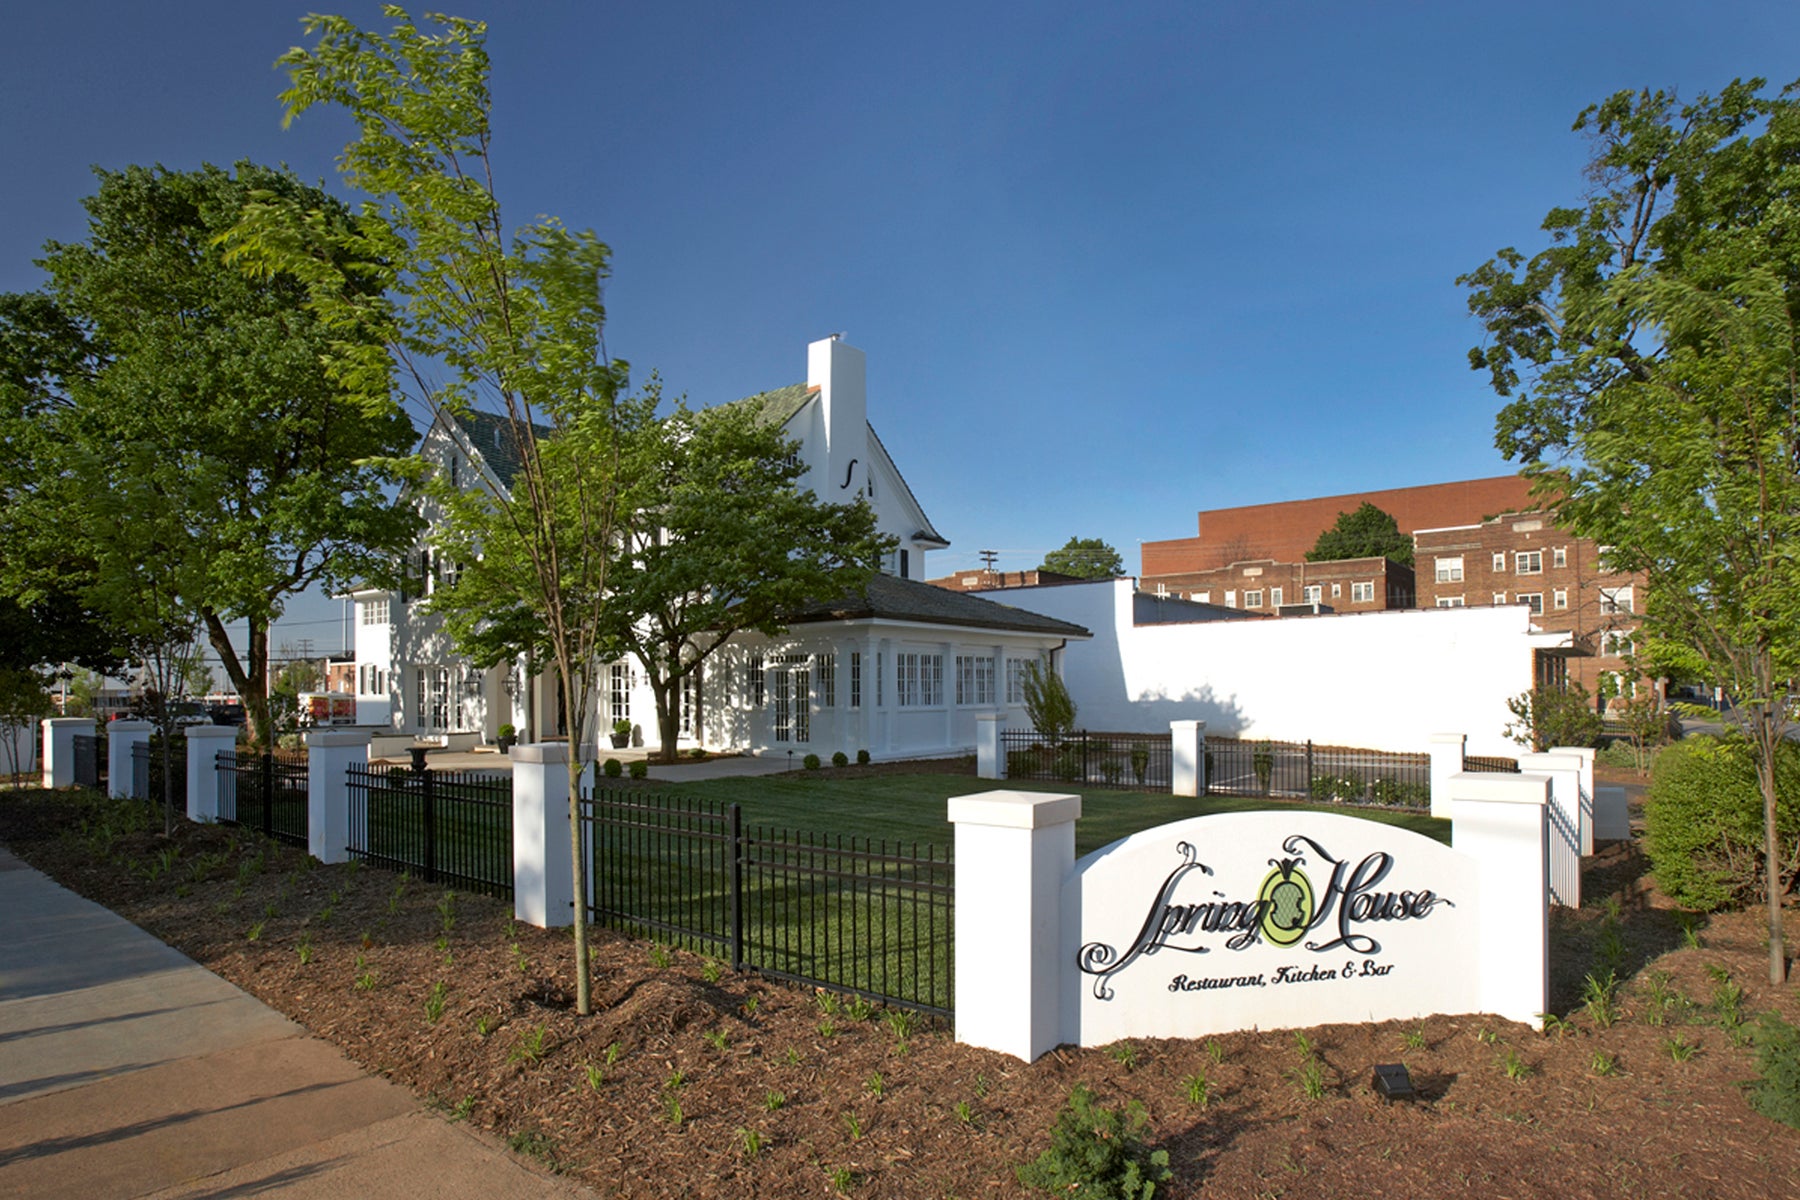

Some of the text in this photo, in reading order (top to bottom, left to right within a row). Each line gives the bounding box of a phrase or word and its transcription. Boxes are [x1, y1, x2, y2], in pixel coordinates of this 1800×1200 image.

[1077, 835, 1456, 1000] Spring House
[1168, 959, 1395, 992] Restaurant, Kitchen & Bar
